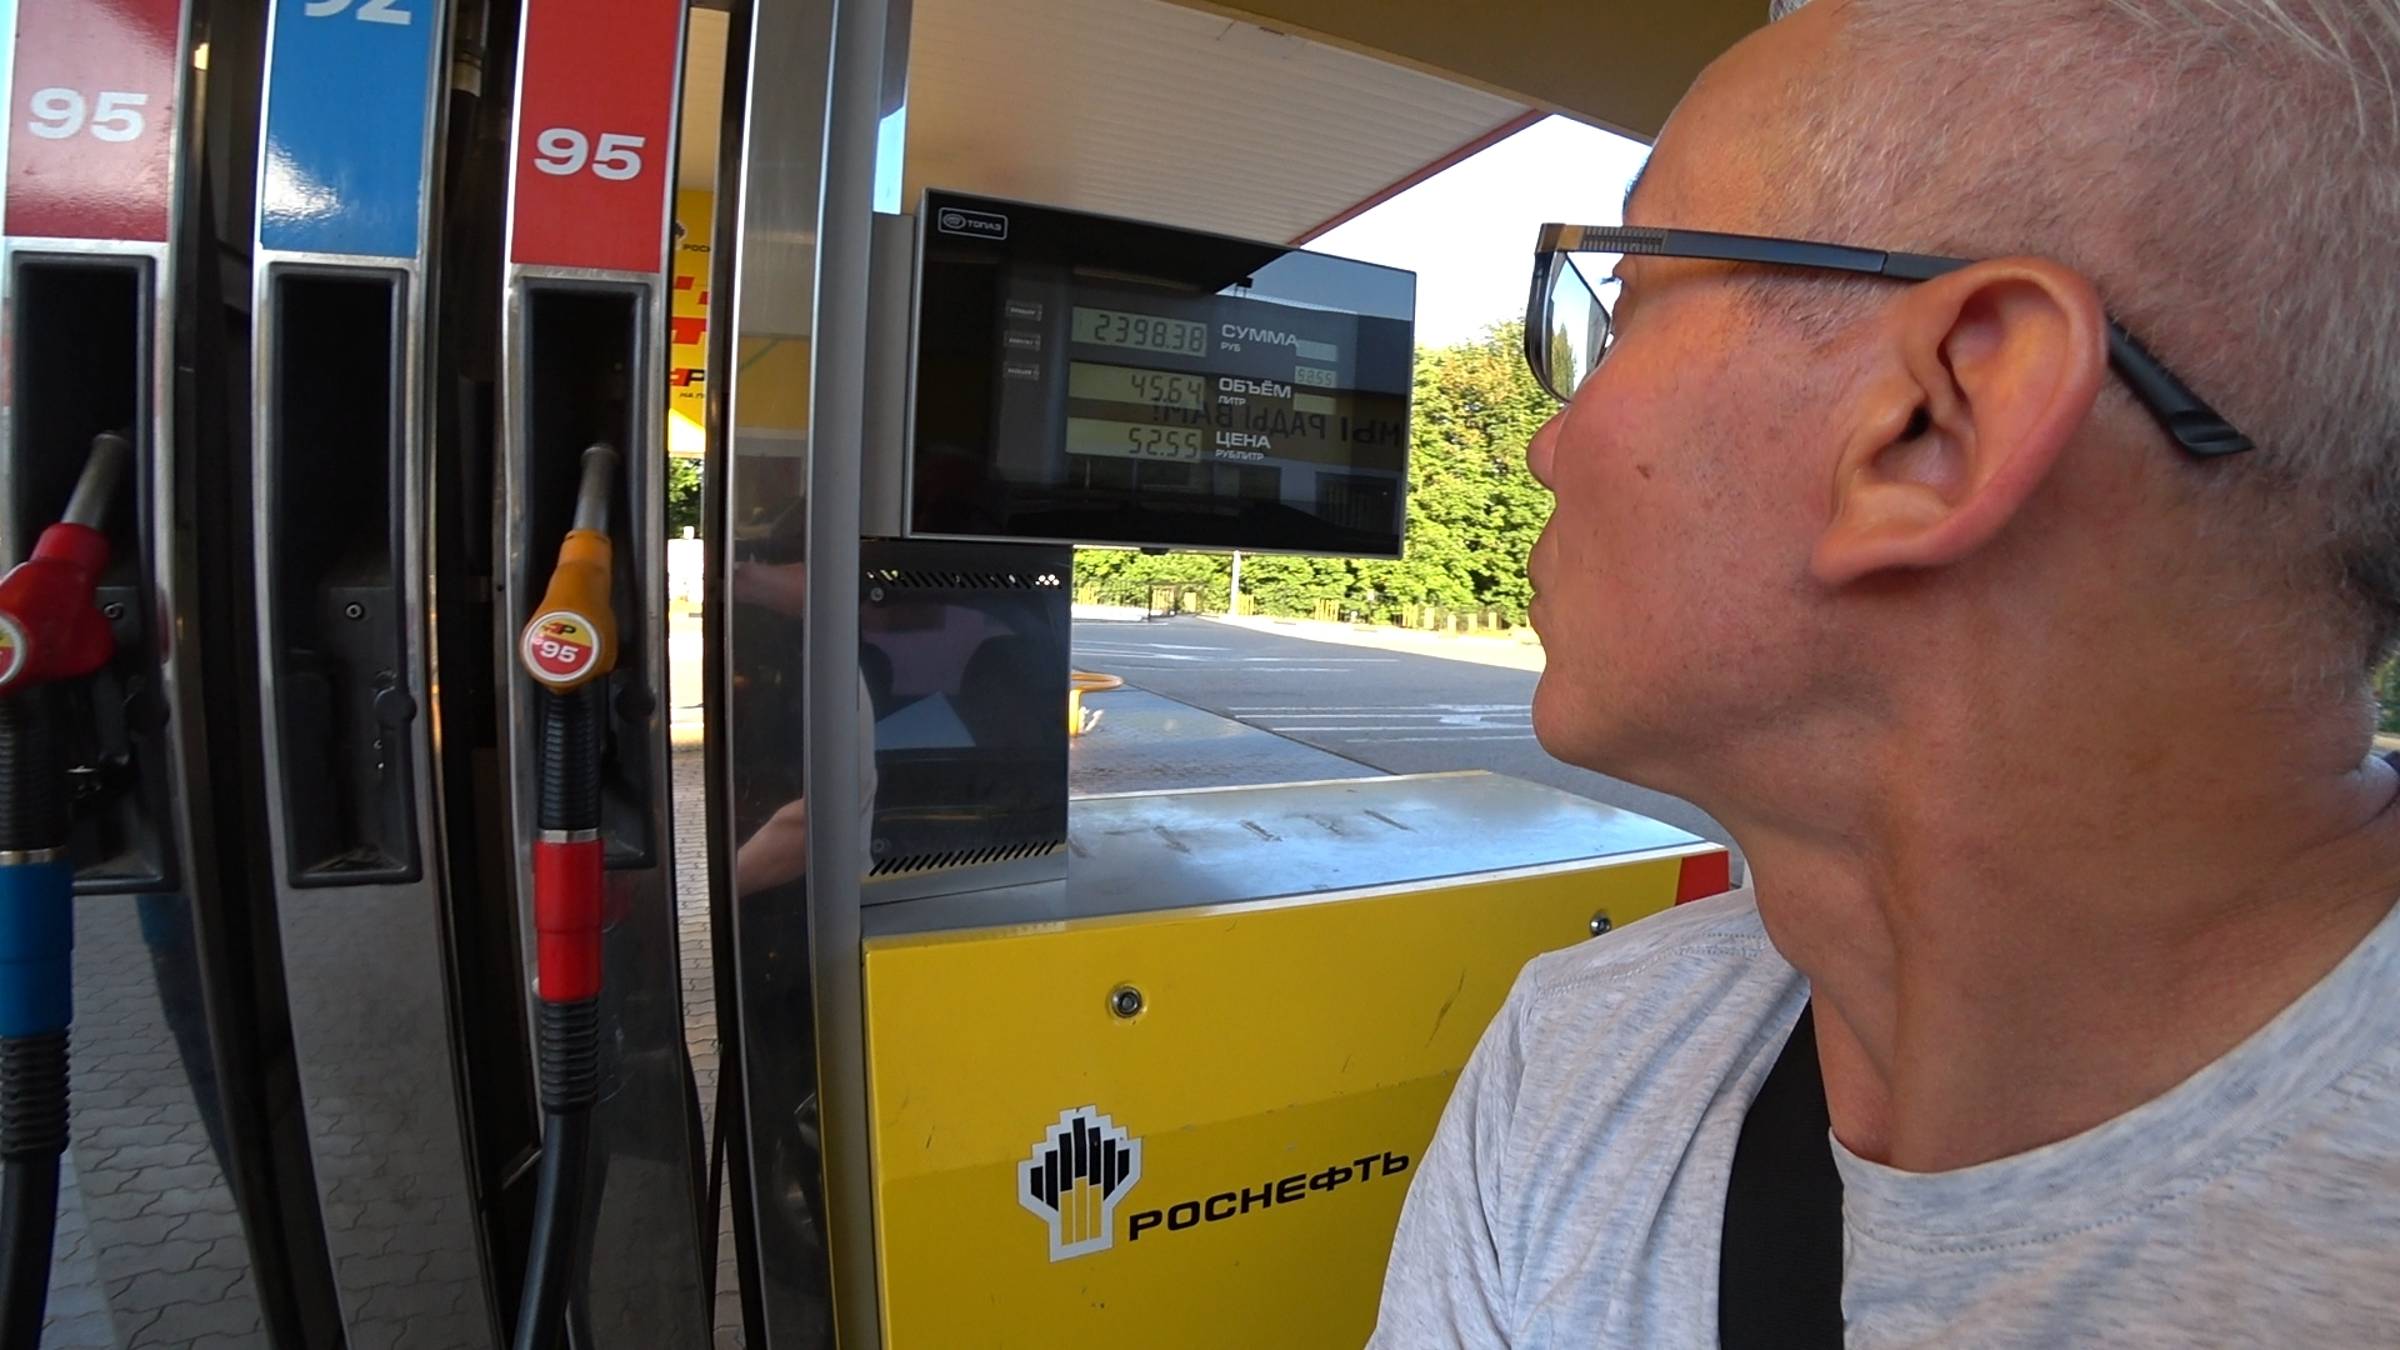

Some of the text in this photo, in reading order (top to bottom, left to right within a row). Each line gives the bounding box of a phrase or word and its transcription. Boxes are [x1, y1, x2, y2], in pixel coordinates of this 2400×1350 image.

[28, 87, 149, 142] 95
[534, 128, 646, 180] 95
[1095, 313, 1204, 353] 2398.38
[1220, 341, 1241, 352] РУБ
[1221, 323, 1299, 346] СУММА
[1131, 373, 1201, 405] 45.64
[1219, 377, 1291, 399] ОБЪЁМ
[1129, 427, 1198, 459] 52.55
[1216, 431, 1271, 449] ЦЕНА
[540, 640, 579, 663] 95
[1129, 1151, 1409, 1241] РОСНЕФТЬ
